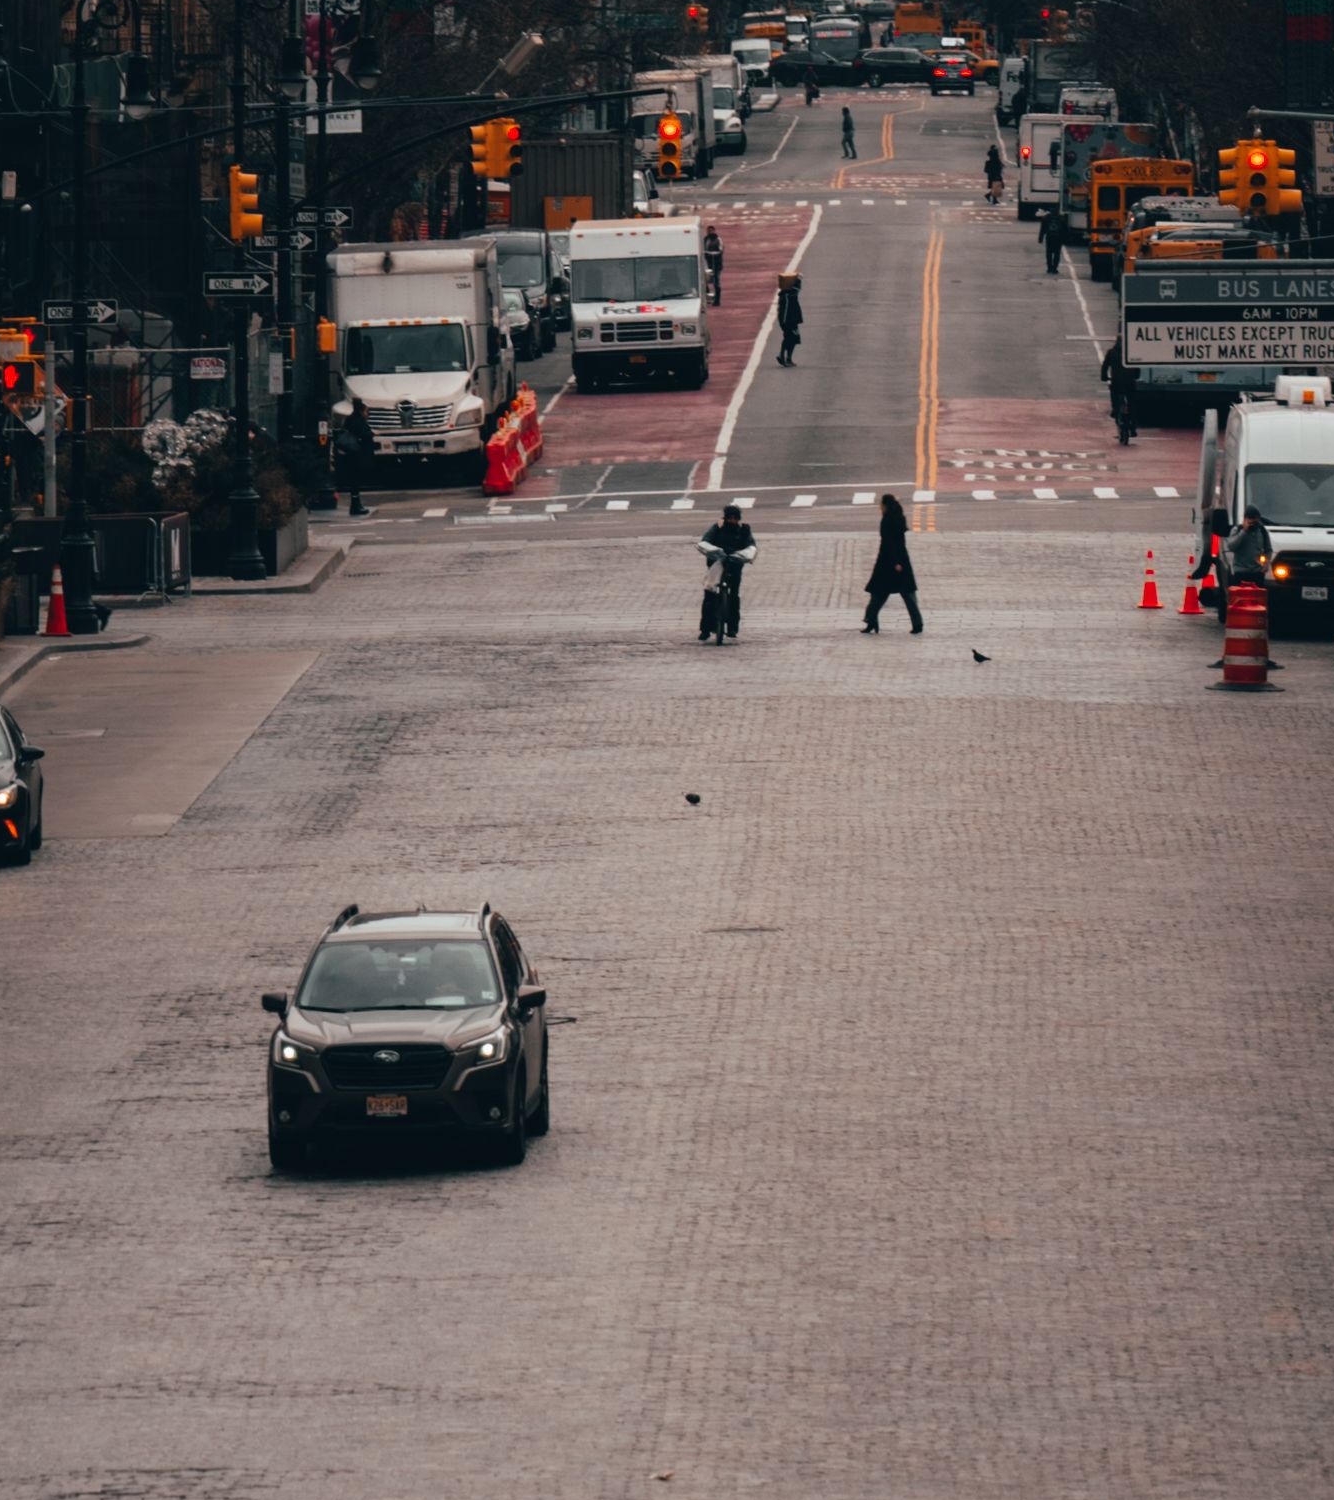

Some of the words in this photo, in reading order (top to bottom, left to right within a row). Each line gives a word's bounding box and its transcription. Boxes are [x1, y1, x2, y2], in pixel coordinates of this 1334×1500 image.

[1150, 166, 1163, 176] BUS
[260, 236, 277, 245] ONE
[214, 280, 234, 289] ONE
[243, 280, 264, 289] WAY
[1218, 280, 1260, 297] BUS
[49, 308, 73, 319] ONE
[603, 304, 667, 315] FedEx
[1242, 308, 1271, 320] 6AM
[1286, 308, 1317, 320] 10PM
[1136, 327, 1161, 341] ALL
[1167, 327, 1236, 341] VEHICLES
[1242, 327, 1294, 341] EXCEPT
[1174, 345, 1214, 359] MUST
[1218, 345, 1256, 359] MAKE
[1263, 345, 1297, 359] NEXT
